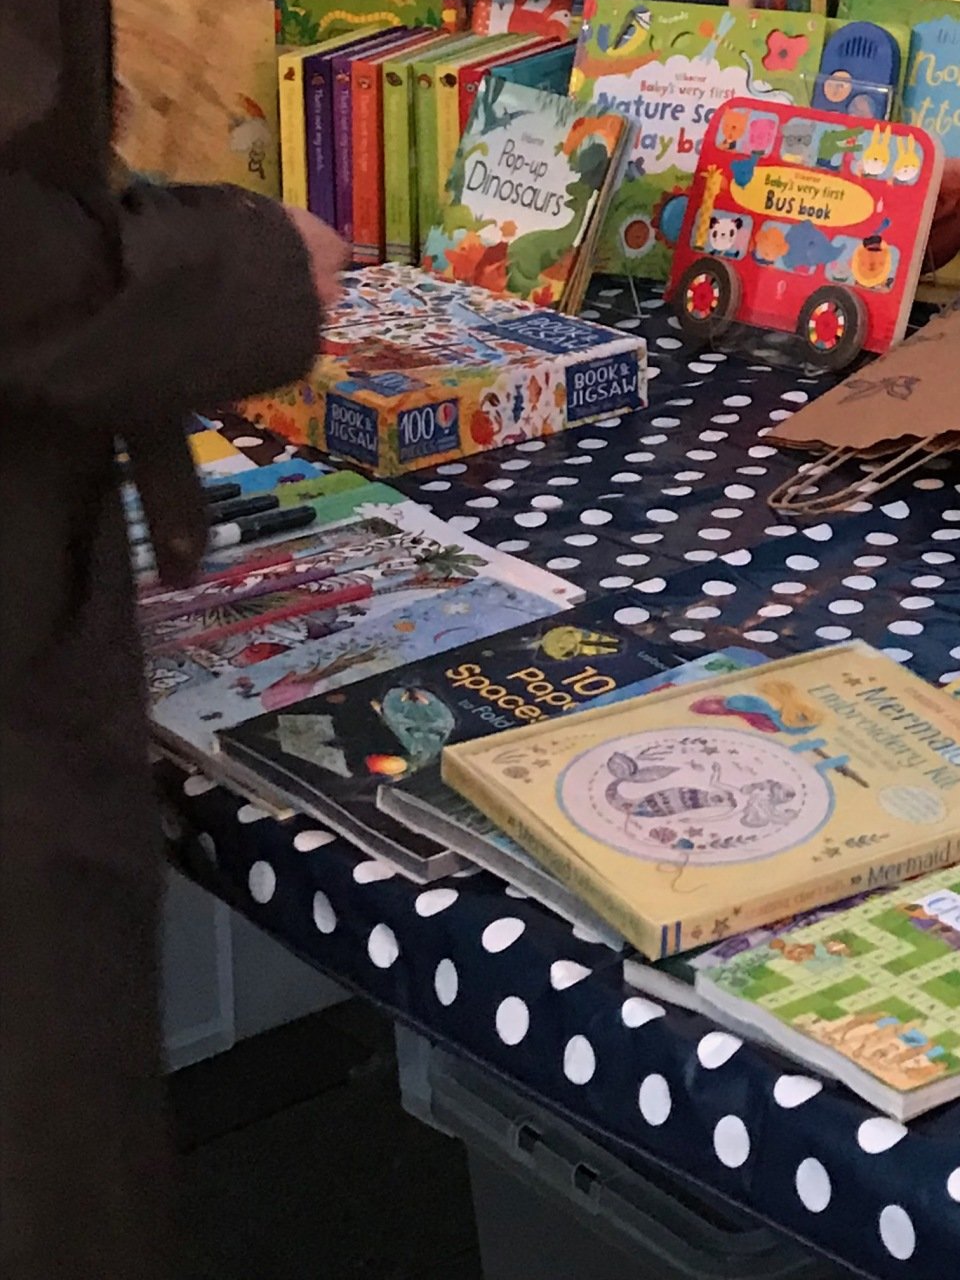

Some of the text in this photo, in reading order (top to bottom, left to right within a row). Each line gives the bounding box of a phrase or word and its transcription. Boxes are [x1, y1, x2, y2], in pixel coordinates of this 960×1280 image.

[639, 79, 736, 100] Baby's very first
[597, 92, 686, 121] Nature
[498, 138, 549, 182] Pop-up
[466, 159, 565, 217] Dinosaurs
[764, 174, 845, 201] Baby's very first
[764, 190, 831, 220] BUS book
[568, 375, 638, 408] JIGSAW
[574, 363, 619, 390] BOOK
[331, 403, 366, 428] BOOK
[400, 407, 435, 445] 100
[329, 421, 377, 451] JIGSAW
[561, 665, 617, 697] 10
[807, 683, 928, 769] Embroidery
[867, 839, 952, 887] Mermaid
